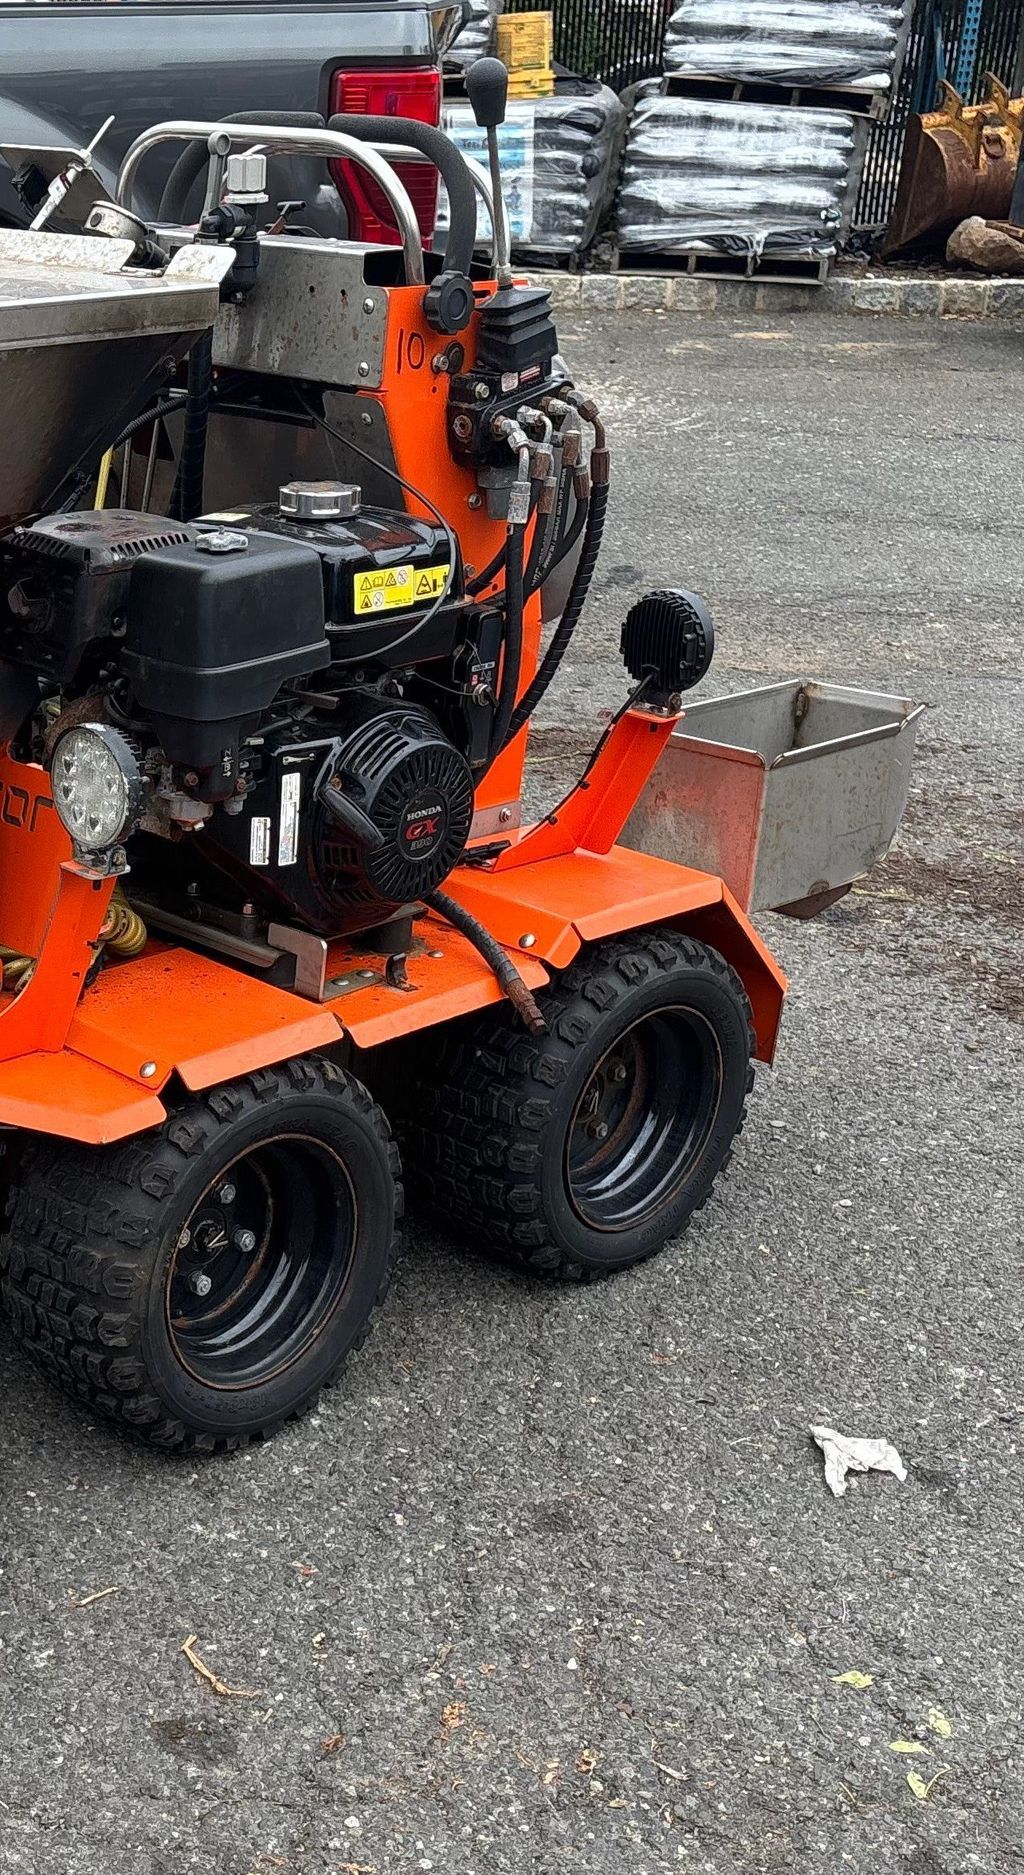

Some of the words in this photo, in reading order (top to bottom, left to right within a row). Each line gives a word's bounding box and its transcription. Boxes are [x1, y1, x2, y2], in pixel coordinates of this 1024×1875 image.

[396, 328, 425, 375] 10
[406, 805, 442, 821] HONDA
[406, 816, 439, 840] GX
